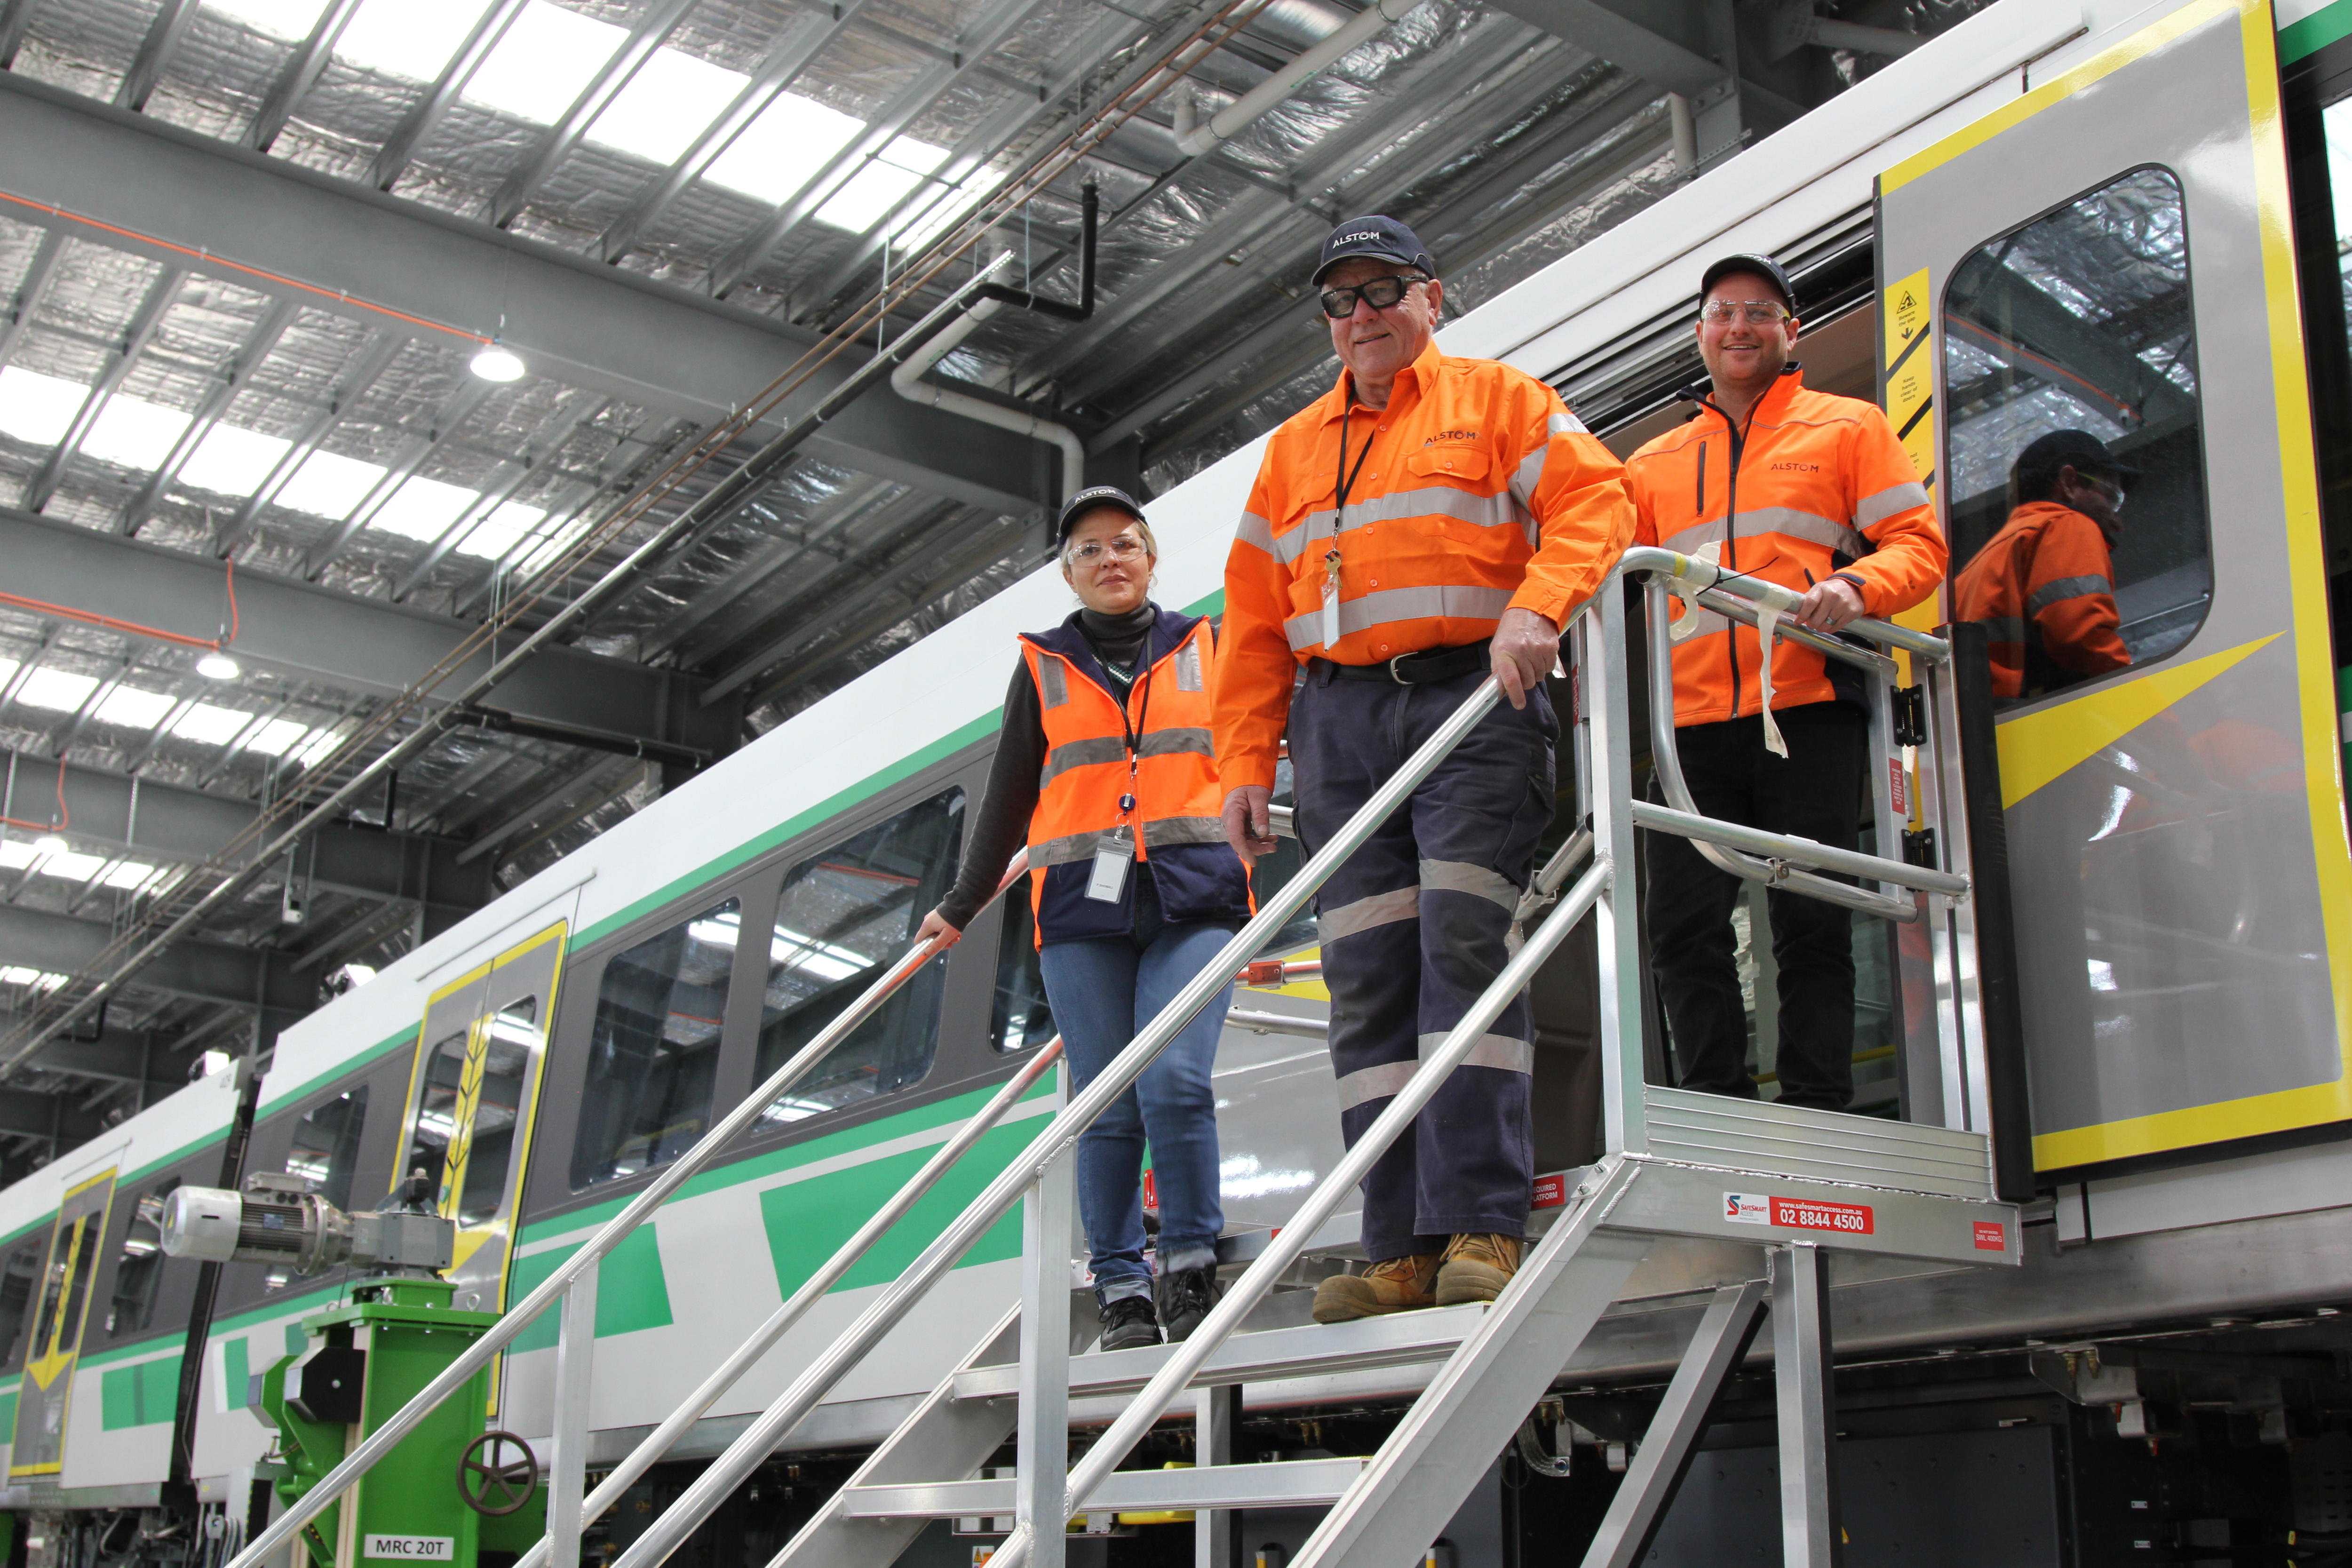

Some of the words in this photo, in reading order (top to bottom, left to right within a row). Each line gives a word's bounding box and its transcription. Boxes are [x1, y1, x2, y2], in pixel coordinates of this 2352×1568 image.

[1332, 231, 1379, 249] ALSTOM
[1899, 310, 1915, 321] Beware
[1902, 382, 1915, 390] hands
[1425, 430, 1475, 445] ALSTOM
[1771, 463, 1819, 473] ALSTOM
[1075, 489, 1116, 503] ALSTOM
[1533, 1183, 1557, 1194] EQUIRED
[1533, 1191, 1558, 1202] LATFORM
[1779, 1202, 1862, 1215] www.safesmartaccess.com.au
[1780, 1209, 1796, 1224] 02
[1799, 1210, 1830, 1227] 8844
[1834, 1214, 1864, 1231] 4500
[377, 1540, 412, 1554] MRC
[417, 1541, 445, 1554] 20T
